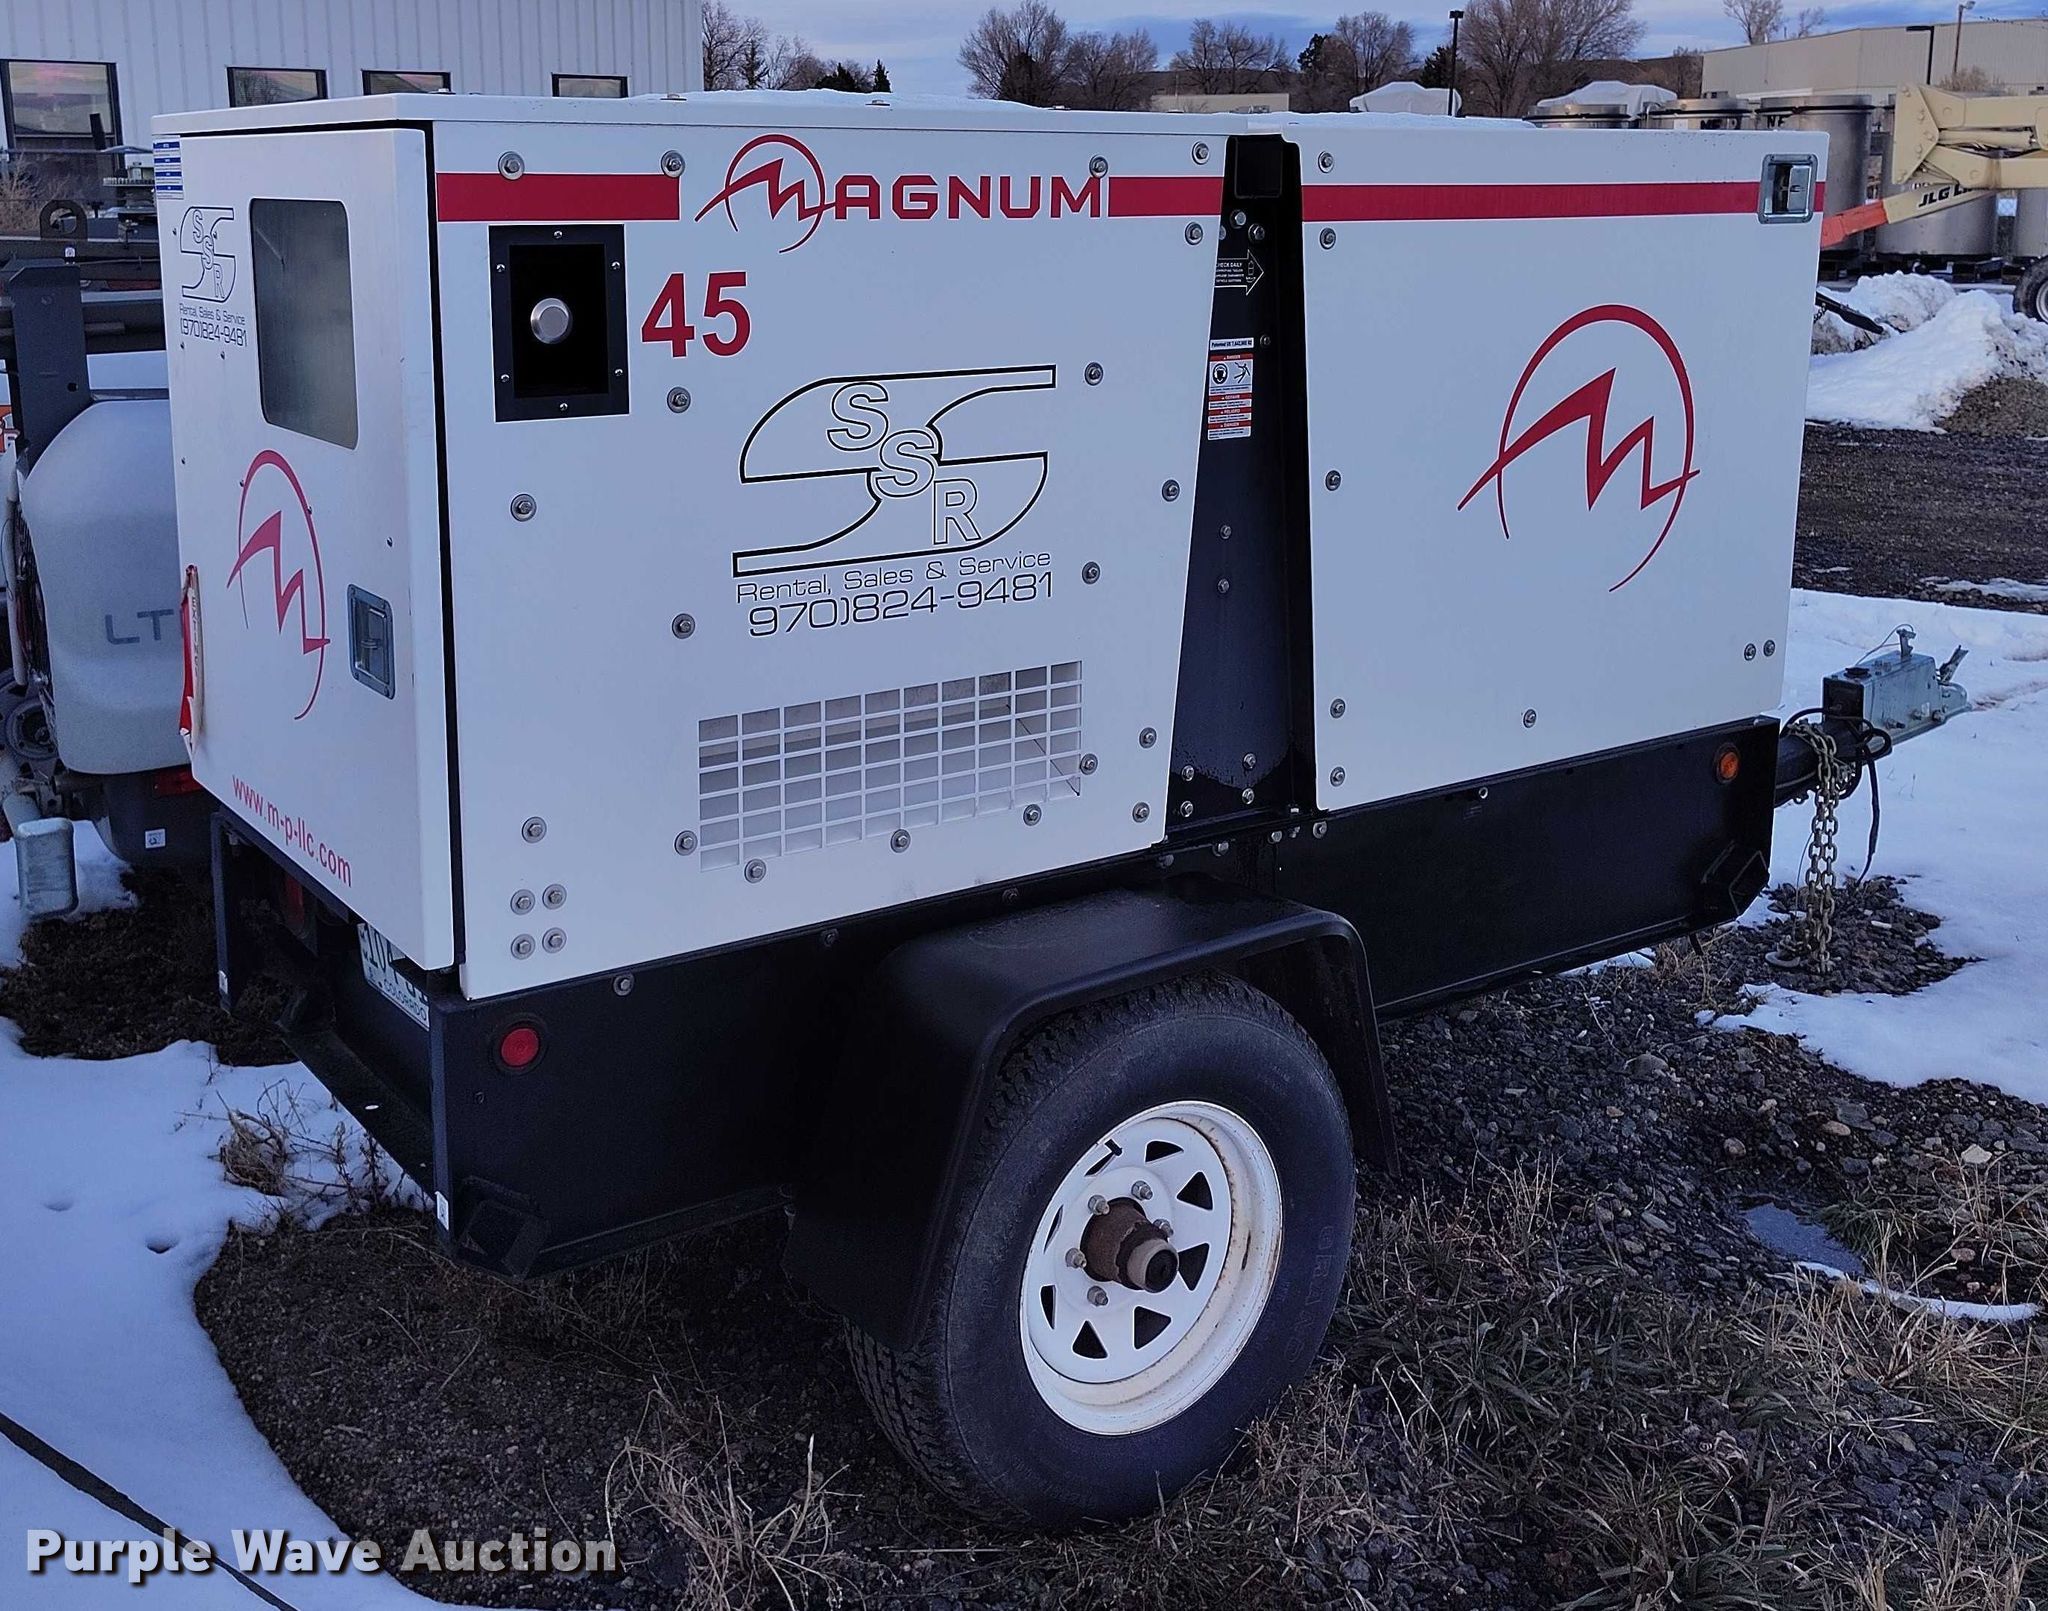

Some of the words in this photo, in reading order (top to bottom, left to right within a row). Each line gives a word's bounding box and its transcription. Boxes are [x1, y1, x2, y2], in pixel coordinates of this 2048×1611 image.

[1918, 186, 1951, 208] JLG
[199, 306, 214, 321] Sales
[223, 310, 246, 326] Service
[641, 271, 752, 357] 45
[736, 575, 832, 604] Rental,
[844, 567, 914, 592] Sales
[925, 561, 948, 580] &
[959, 551, 1052, 576] Service
[749, 571, 1053, 638] 970)824-9481
[231, 774, 352, 889] www.m-p-llc.com
[383, 978, 427, 1021] COLORADO
